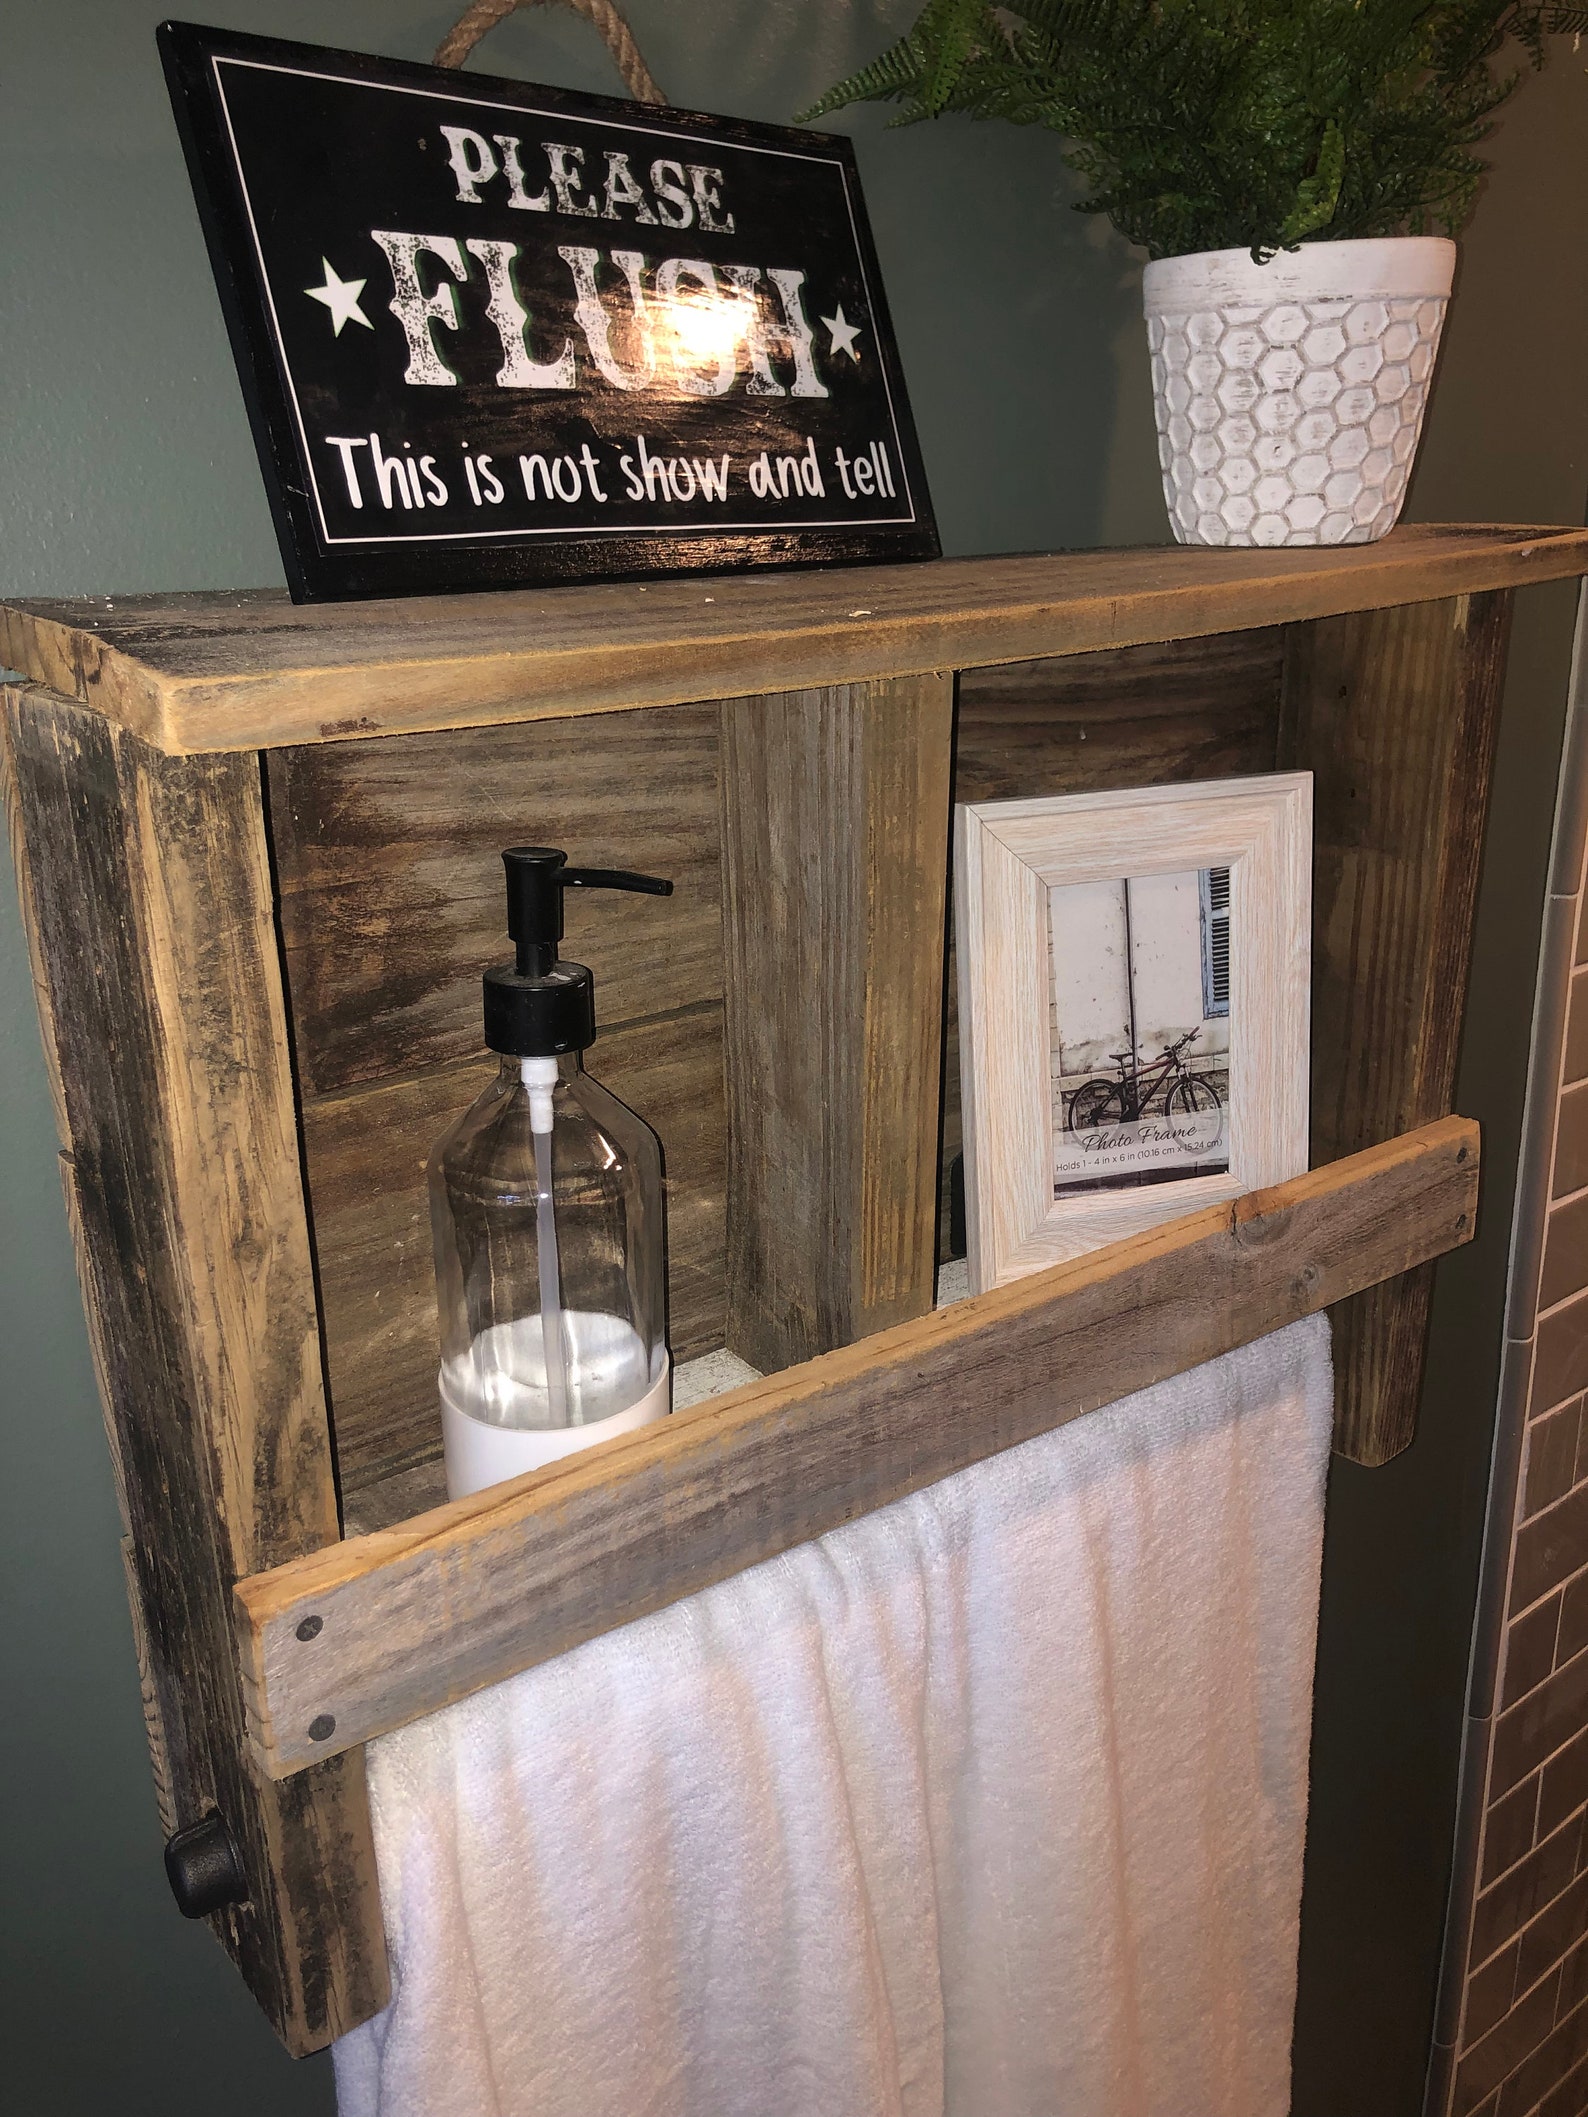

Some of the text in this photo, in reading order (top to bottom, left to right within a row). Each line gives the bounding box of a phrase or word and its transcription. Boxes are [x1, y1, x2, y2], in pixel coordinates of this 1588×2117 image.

[439, 125, 736, 235] PLEASE
[326, 432, 897, 511] This is not show and tell
[1056, 1160, 1081, 1172] Holds
[1102, 1156, 1110, 1164] in
[1119, 1153, 1126, 1162] 6
[1127, 1152, 1135, 1160] in
[1137, 1148, 1160, 1160] (10.16
[1162, 1147, 1175, 1155] cm
[1184, 1141, 1204, 1151] 15.24
[1206, 1138, 1223, 1149] cm)
[1082, 1125, 1198, 1152] Photo Frame
